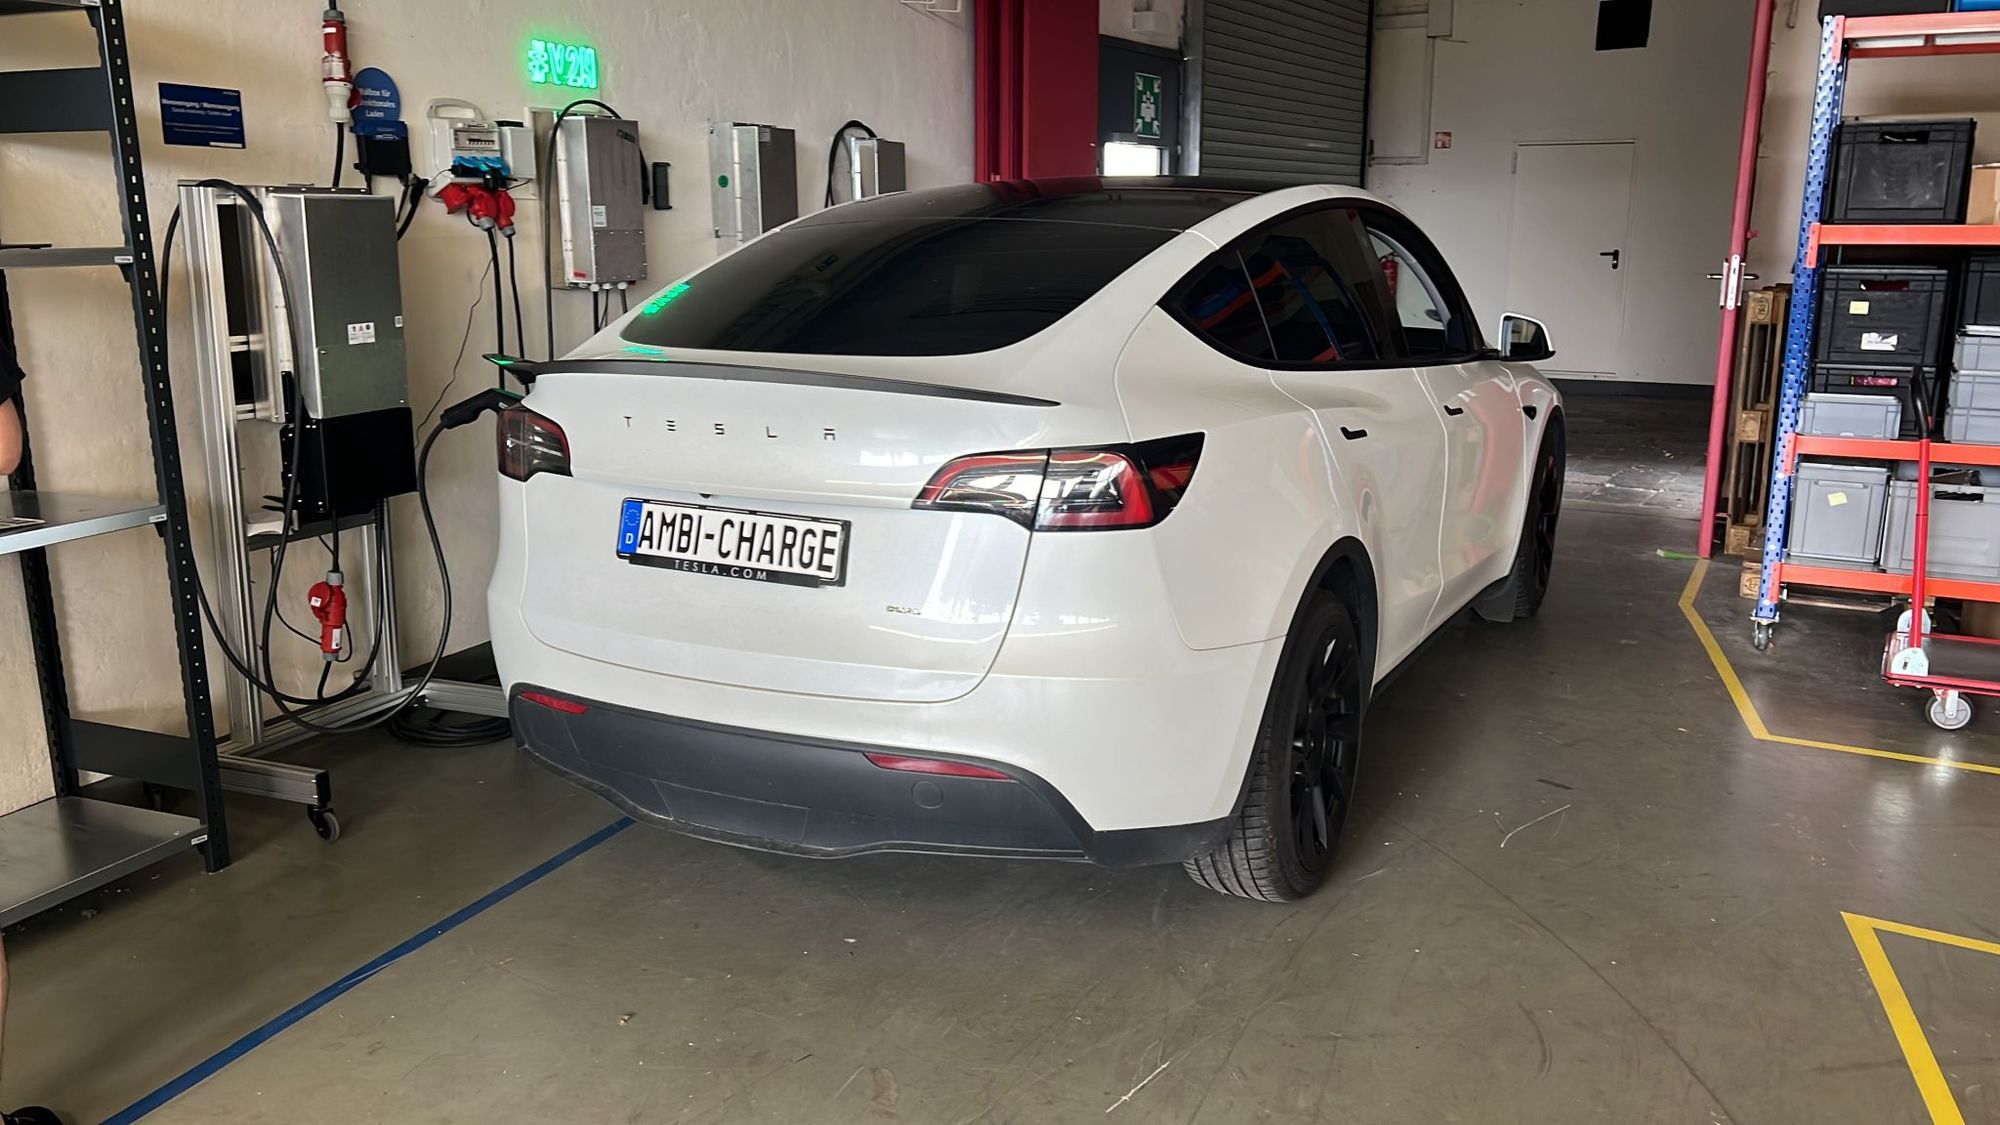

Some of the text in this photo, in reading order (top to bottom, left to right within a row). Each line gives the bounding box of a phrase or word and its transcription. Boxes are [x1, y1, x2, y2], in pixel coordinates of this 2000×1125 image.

[365, 110, 385, 118] Laden
[624, 416, 836, 440] TESLA
[625, 533, 633, 544] D
[638, 510, 838, 573] AMBI-CHARGE
[674, 559, 768, 580] TESLA.COM
